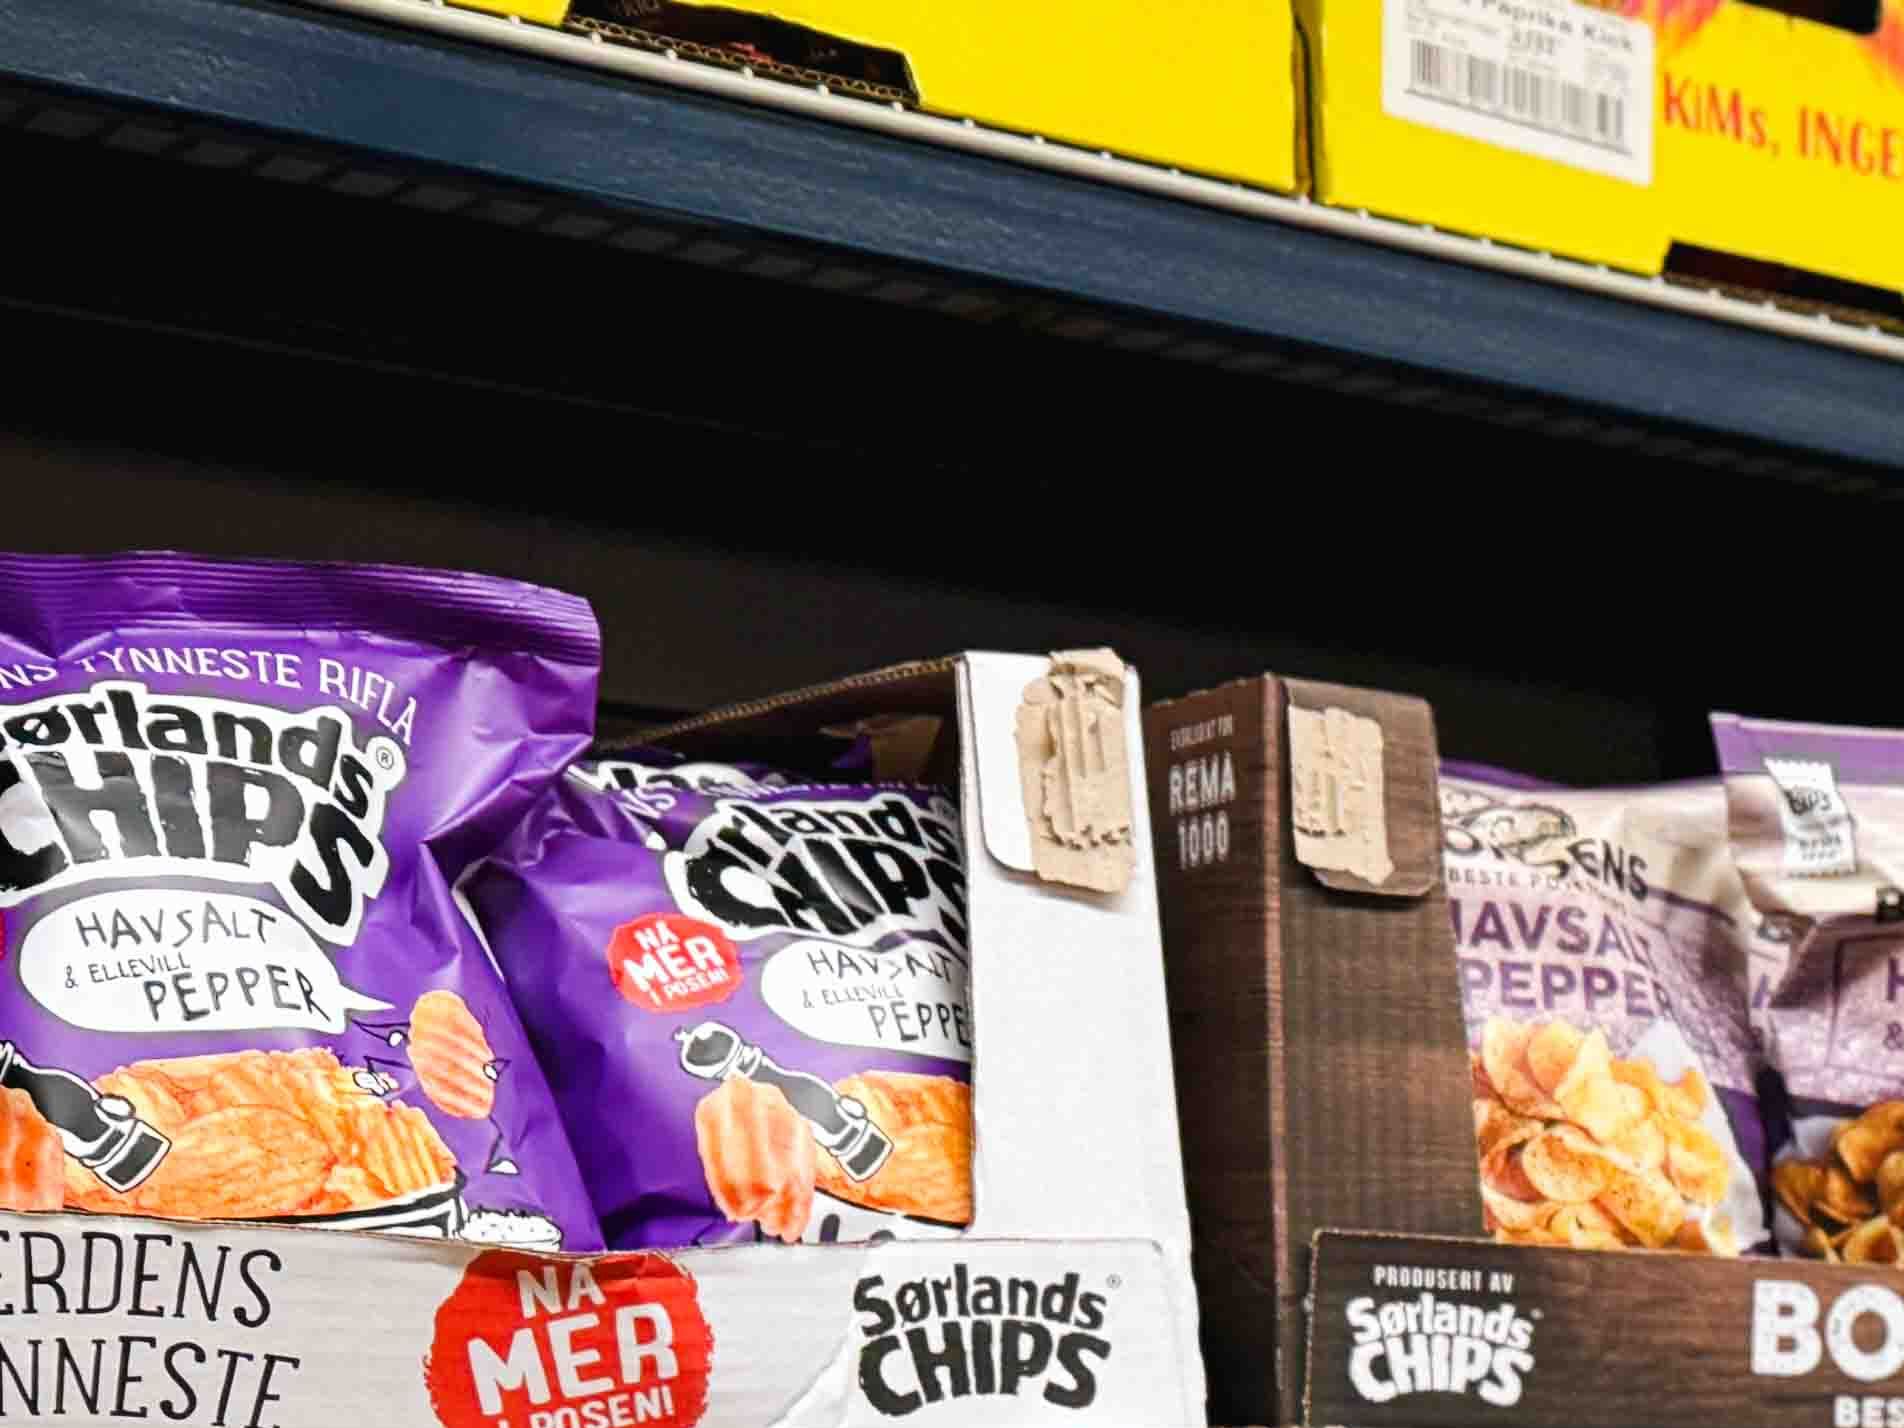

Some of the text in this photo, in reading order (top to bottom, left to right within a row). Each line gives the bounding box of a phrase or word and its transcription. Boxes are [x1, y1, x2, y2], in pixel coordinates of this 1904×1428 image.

[73, 647, 303, 688] TYNNESTE
[0, 689, 374, 819] ørlands
[1168, 750, 1237, 817] REMA
[1177, 810, 1231, 872] 1000
[75, 901, 278, 950] HAVSALT
[64, 950, 192, 990] & ELLEVILL
[143, 962, 332, 1023] PEPPER
[623, 934, 726, 992] MER
[867, 1001, 972, 1046] PEPPE
[853, 1262, 1108, 1338] Sørlands
[1372, 1264, 1516, 1294] PRODUSERT AV
[1346, 1291, 1536, 1350] Sørlands
[467, 1302, 680, 1417] MER
[857, 1318, 1112, 1418] CHIPS
[1348, 1332, 1536, 1408] CHIPS
